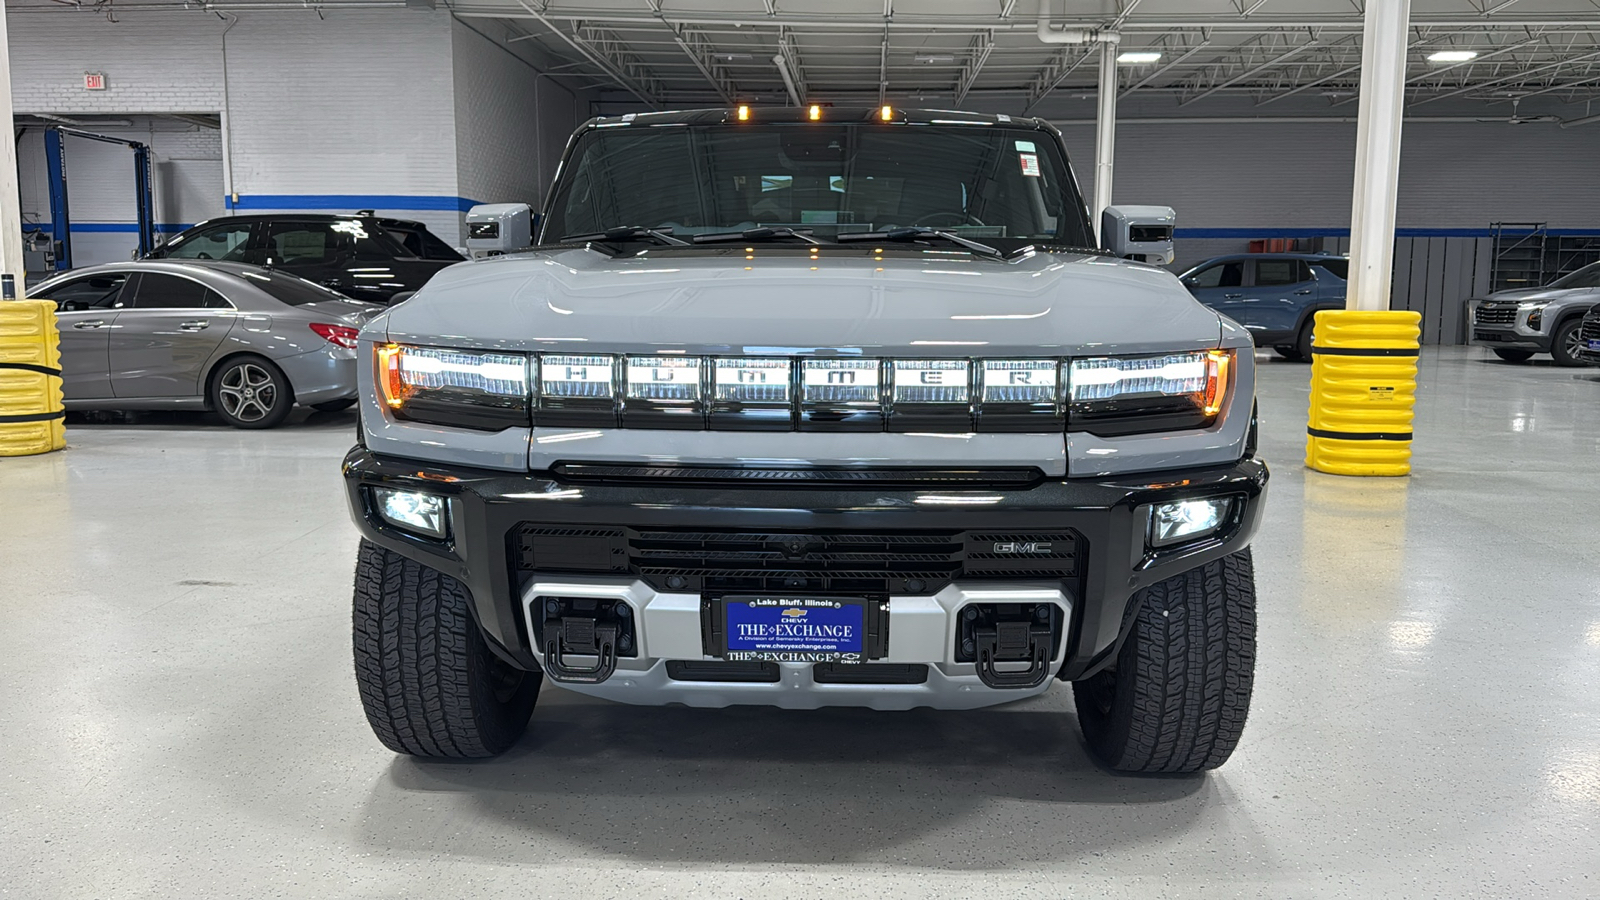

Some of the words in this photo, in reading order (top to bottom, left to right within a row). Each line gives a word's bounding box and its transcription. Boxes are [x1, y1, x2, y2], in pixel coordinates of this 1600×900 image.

[86, 75, 101, 88] EXIT
[993, 542, 1052, 554] GMC
[804, 599, 833, 607] Illinois
[736, 624, 768, 636] THE
[775, 624, 853, 638] EXCHANGE
[755, 643, 837, 651] www.chevyexchange.com
[727, 651, 752, 661] THE
[763, 652, 834, 662] EXCHANGE
